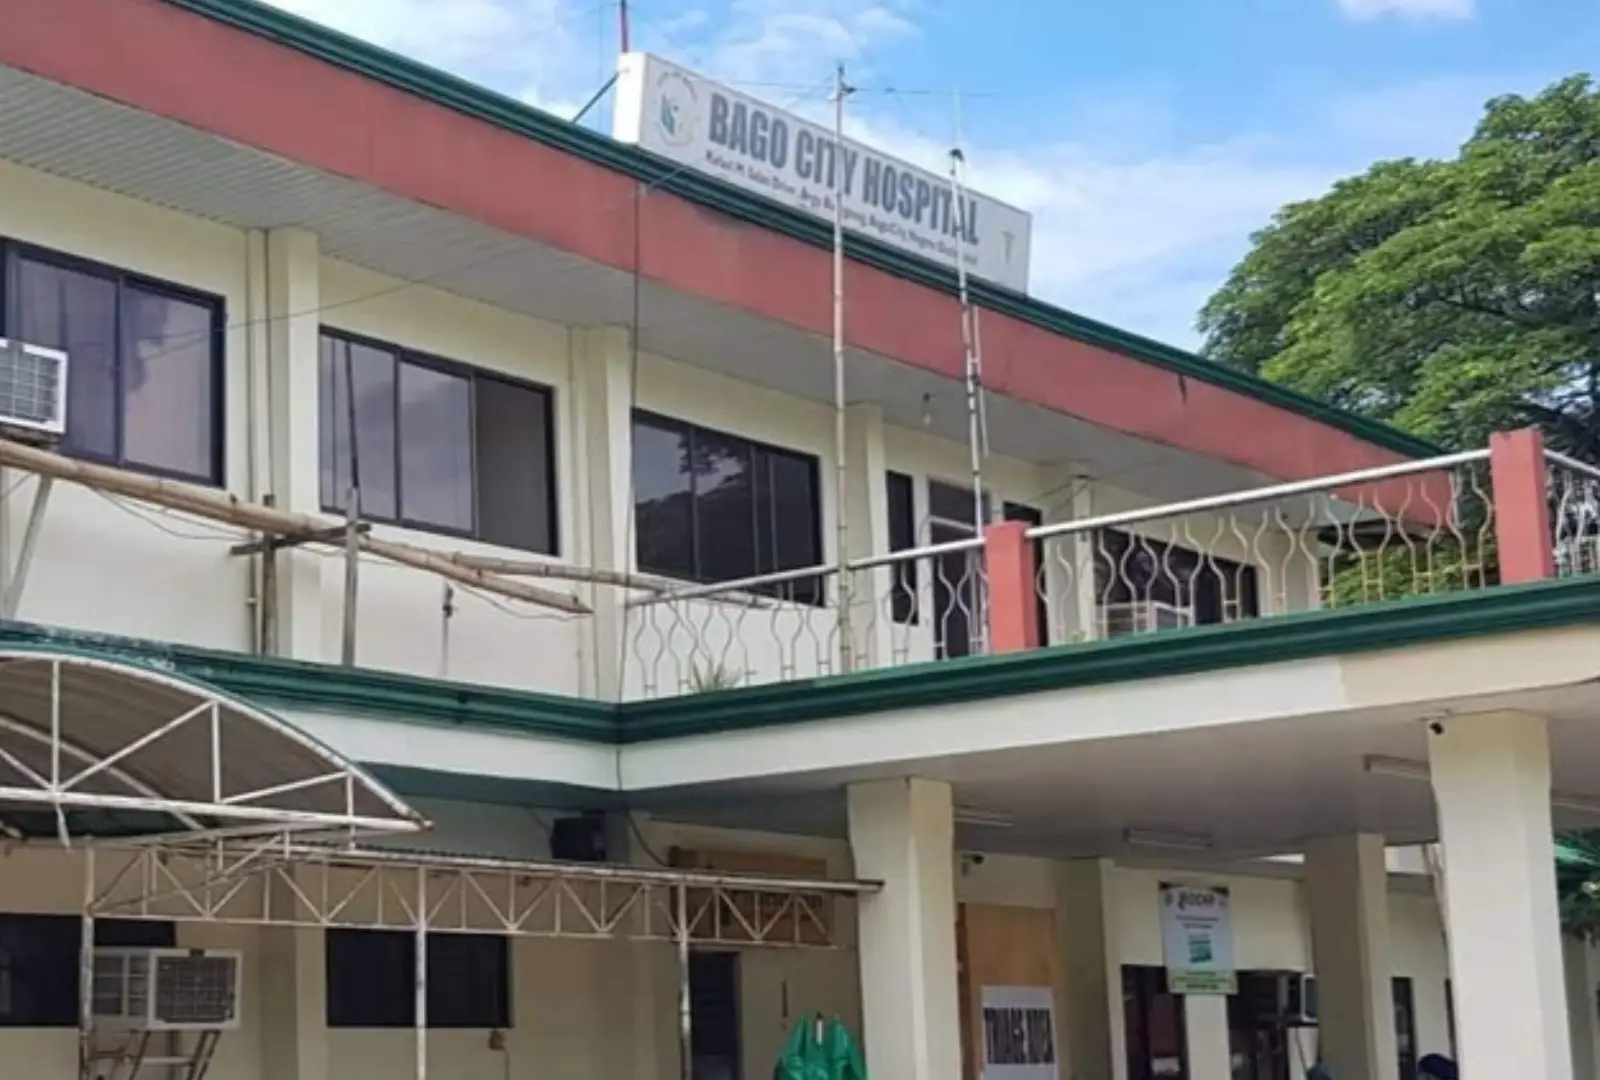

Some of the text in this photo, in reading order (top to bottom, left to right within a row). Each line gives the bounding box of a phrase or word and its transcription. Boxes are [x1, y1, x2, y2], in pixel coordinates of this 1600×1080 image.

[708, 92, 788, 169] BAGO
[795, 128, 857, 196] CITY
[863, 156, 979, 247] HOSPITAL
